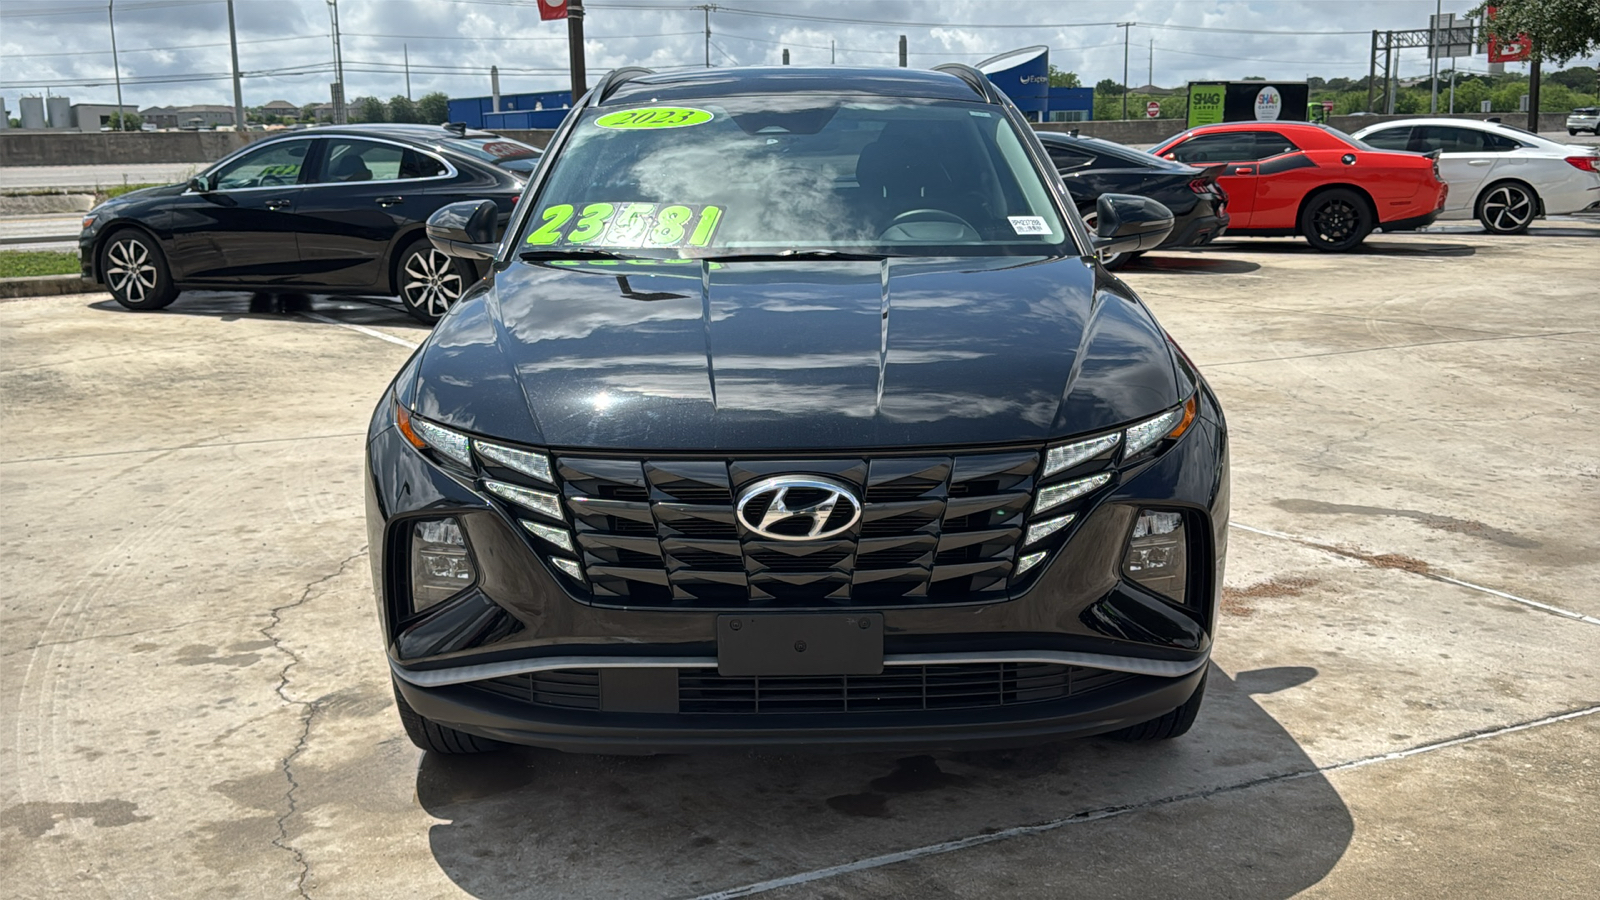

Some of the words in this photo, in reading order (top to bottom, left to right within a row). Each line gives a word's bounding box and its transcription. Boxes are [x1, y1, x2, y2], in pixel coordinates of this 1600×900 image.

[1193, 92, 1220, 105] SHAG
[1258, 93, 1278, 105] SHAG
[611, 110, 696, 126] 2023
[526, 202, 722, 247] 23581
